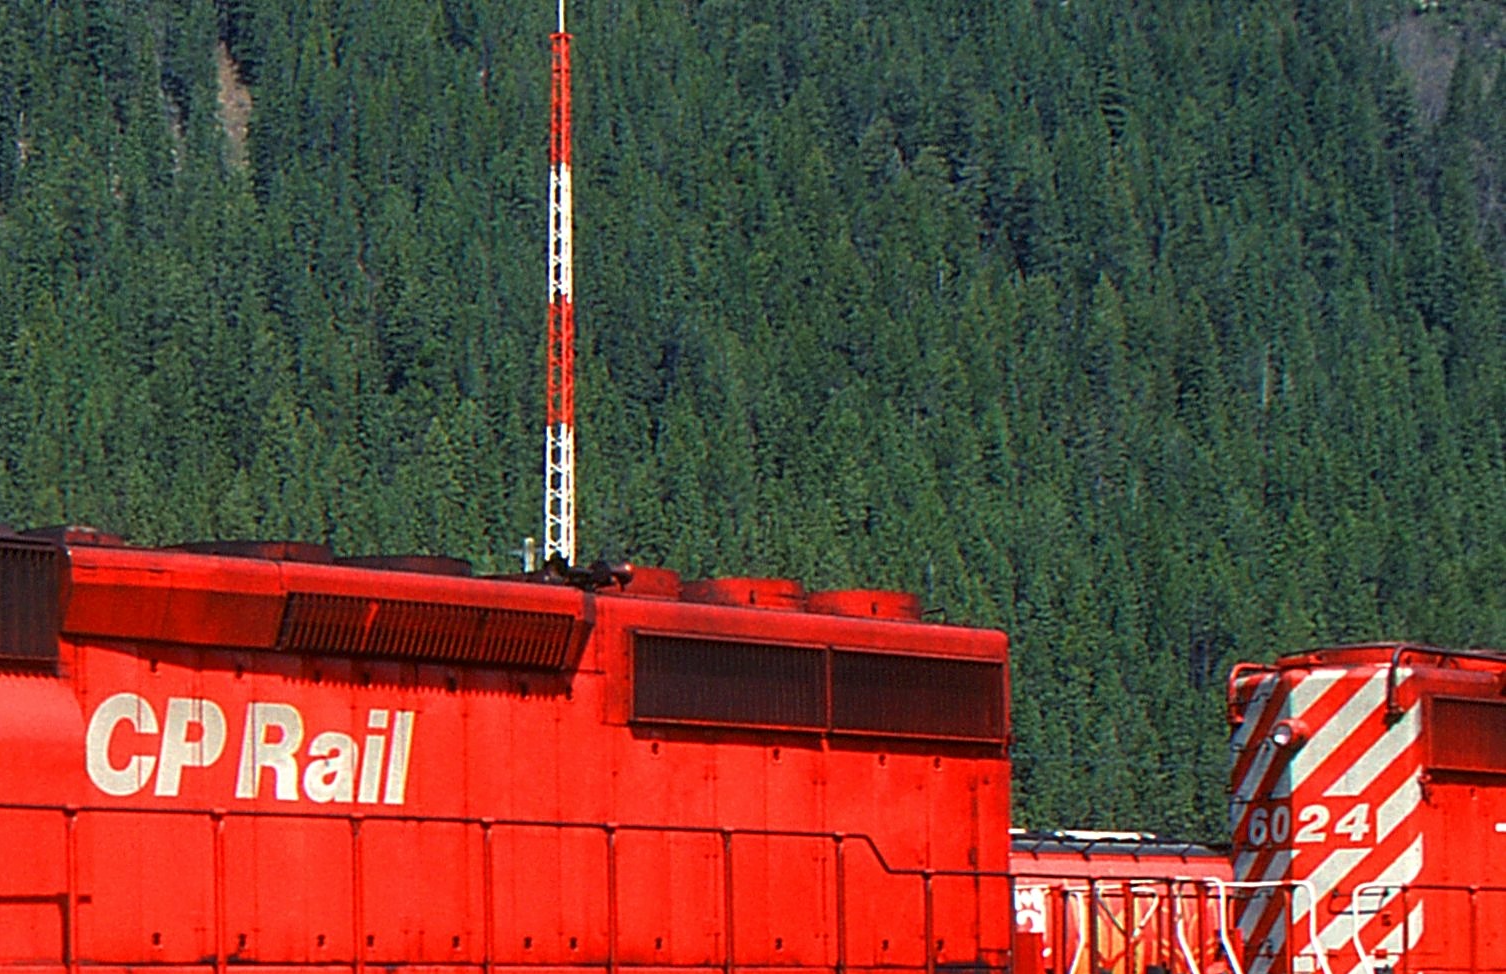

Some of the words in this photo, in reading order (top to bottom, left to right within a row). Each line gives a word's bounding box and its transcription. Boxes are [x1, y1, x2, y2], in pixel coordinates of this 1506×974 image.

[86, 692, 227, 797] CP
[235, 701, 415, 805] Rail
[1248, 803, 1370, 845] 6024
